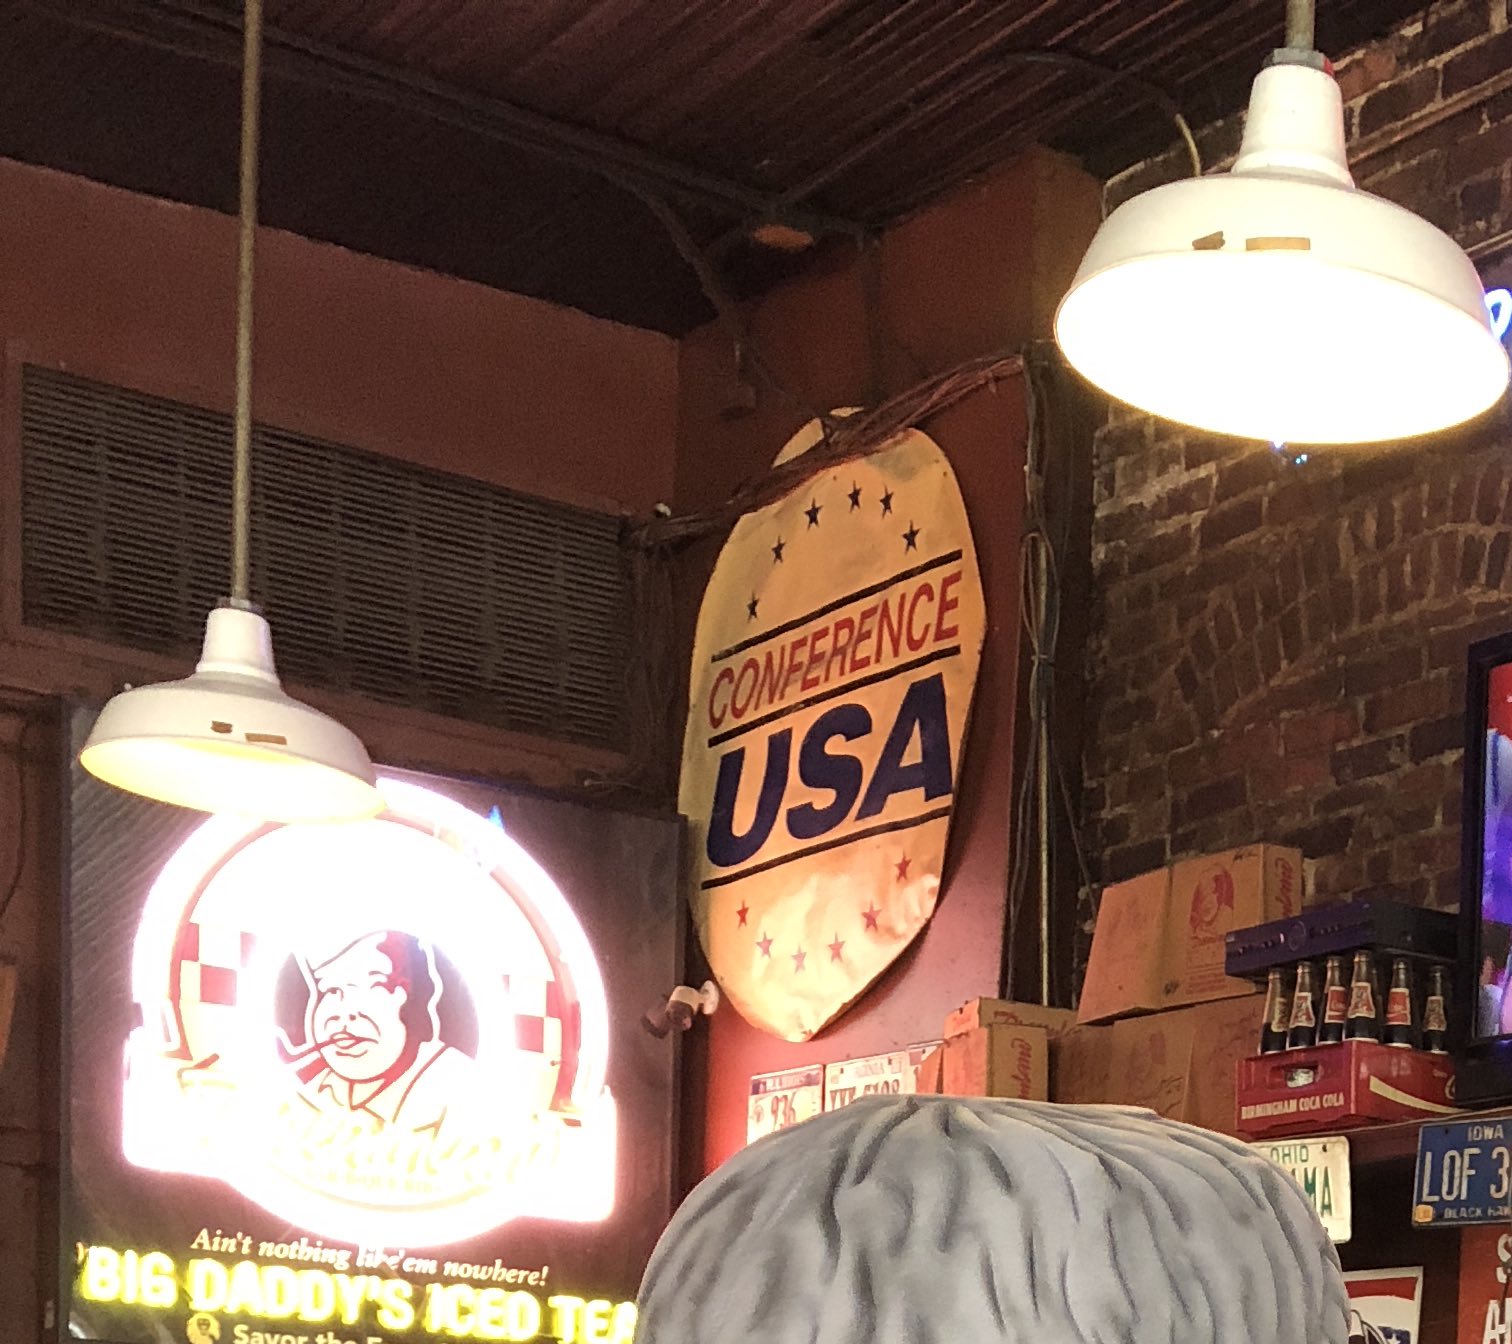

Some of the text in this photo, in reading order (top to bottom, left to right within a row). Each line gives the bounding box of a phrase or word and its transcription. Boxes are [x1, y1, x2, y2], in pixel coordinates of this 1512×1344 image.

[707, 569, 963, 730] CONFERENCE
[706, 674, 954, 868] USA
[1241, 1092, 1345, 1120] BIRMINGHAM COCA COLA
[1467, 1124, 1505, 1142] IOWA
[1270, 1144, 1309, 1163] OHIO
[1422, 1147, 1482, 1202] LOF
[1443, 1206, 1483, 1219] BLACK
[190, 1227, 253, 1256] Ain't
[258, 1241, 351, 1271] nothing
[444, 1259, 550, 1288] nowhere!
[82, 1245, 178, 1308] BIG
[187, 1260, 415, 1332] DADDY'S
[424, 1281, 543, 1342] ICED
